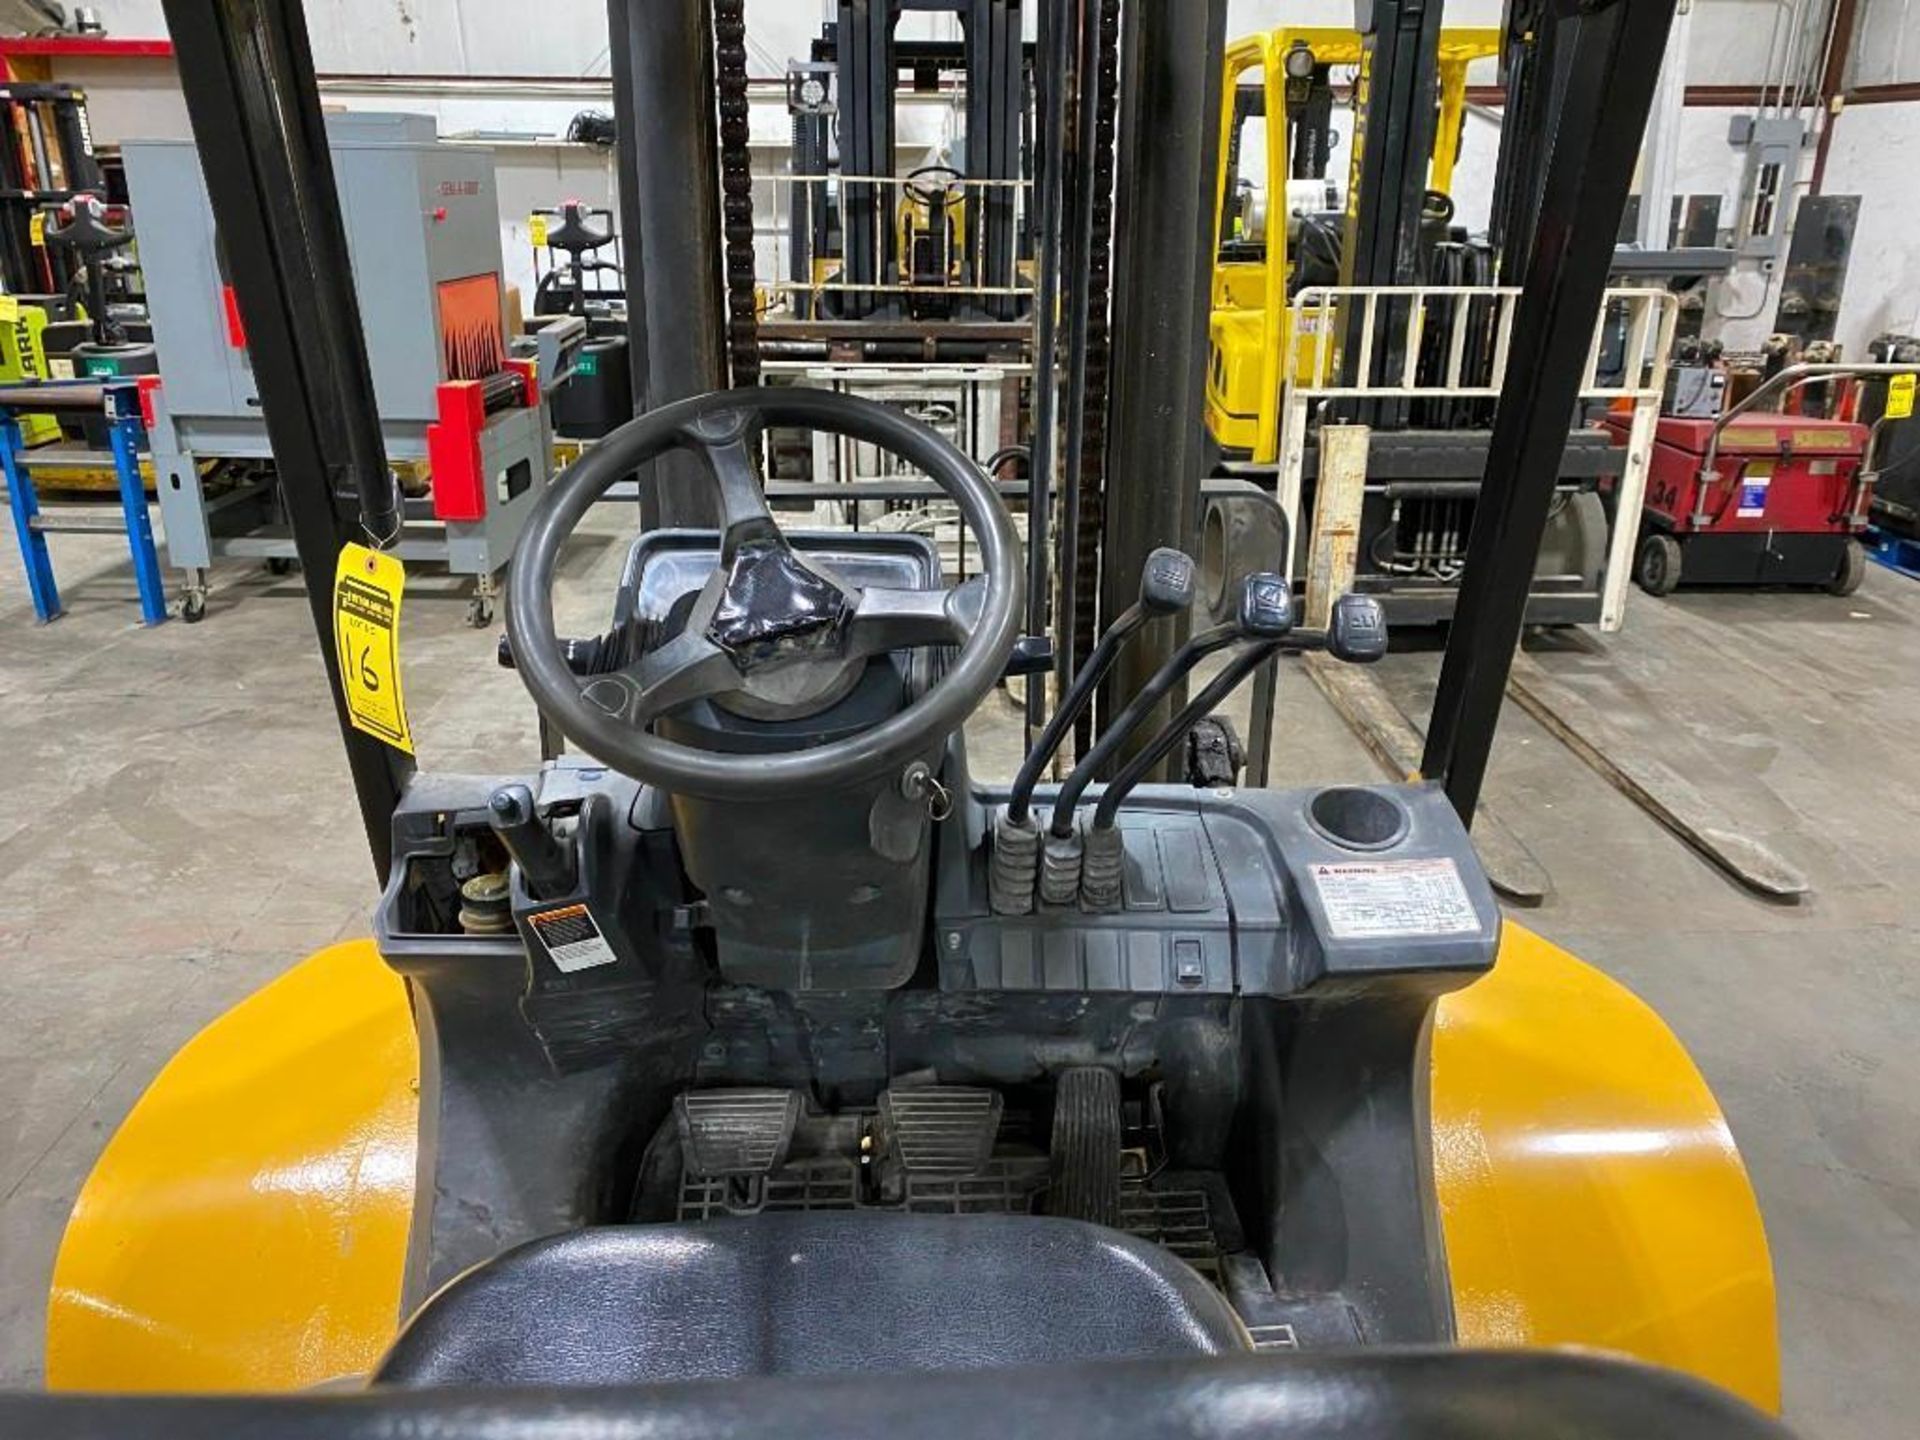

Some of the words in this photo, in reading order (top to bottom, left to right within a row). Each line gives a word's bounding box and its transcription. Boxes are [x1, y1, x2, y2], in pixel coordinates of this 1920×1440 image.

[76, 106, 93, 156] CLARK
[15, 315, 40, 377] ARK
[345, 631, 379, 692] 16
